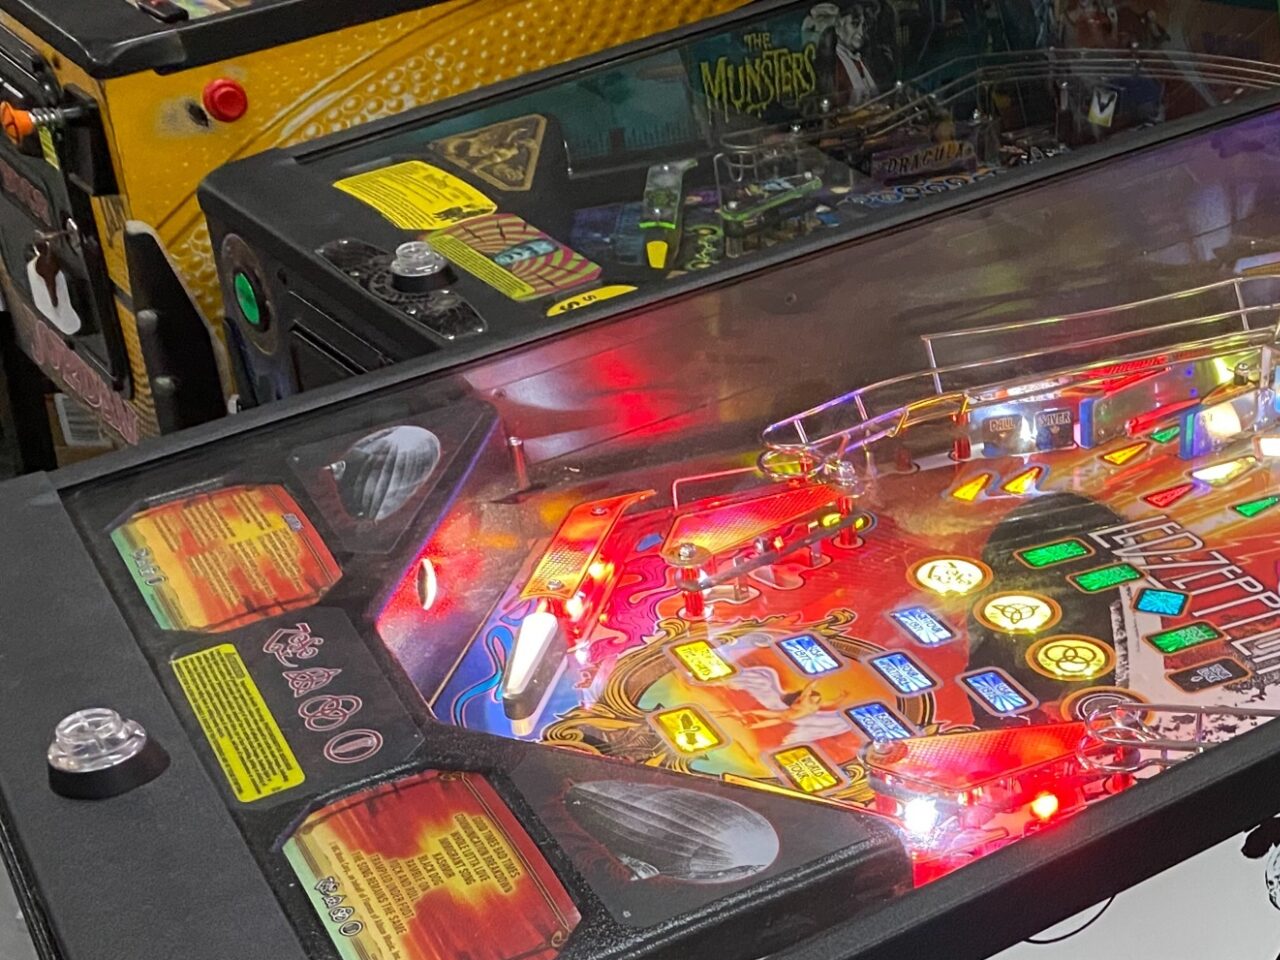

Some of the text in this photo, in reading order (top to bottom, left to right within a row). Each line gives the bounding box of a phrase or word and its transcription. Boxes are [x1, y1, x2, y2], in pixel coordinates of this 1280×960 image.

[744, 32, 773, 49] THE
[700, 43, 817, 121] MUNSTERS
[357, 861, 373, 878] SONG
[417, 854, 443, 886] BLACK DOG
[431, 851, 456, 878] KASHMIR
[437, 836, 476, 886] IMMIGRANT SONG
[449, 830, 490, 882] WHOLE LOTTA LOVE
[482, 830, 500, 848] TIMES
[493, 846, 508, 860] BAD
[501, 858, 520, 878] TIMES
[366, 875, 389, 903] REMAINS
[369, 854, 414, 919] TRAMPLED UNDER FOOT
[398, 873, 412, 887] AND
[405, 886, 420, 902] ROLL
[404, 858, 431, 892] RAMBLE ON
[482, 855, 514, 893] BREAKDOWN
[381, 902, 396, 916] THE
[388, 914, 407, 935] SAME
